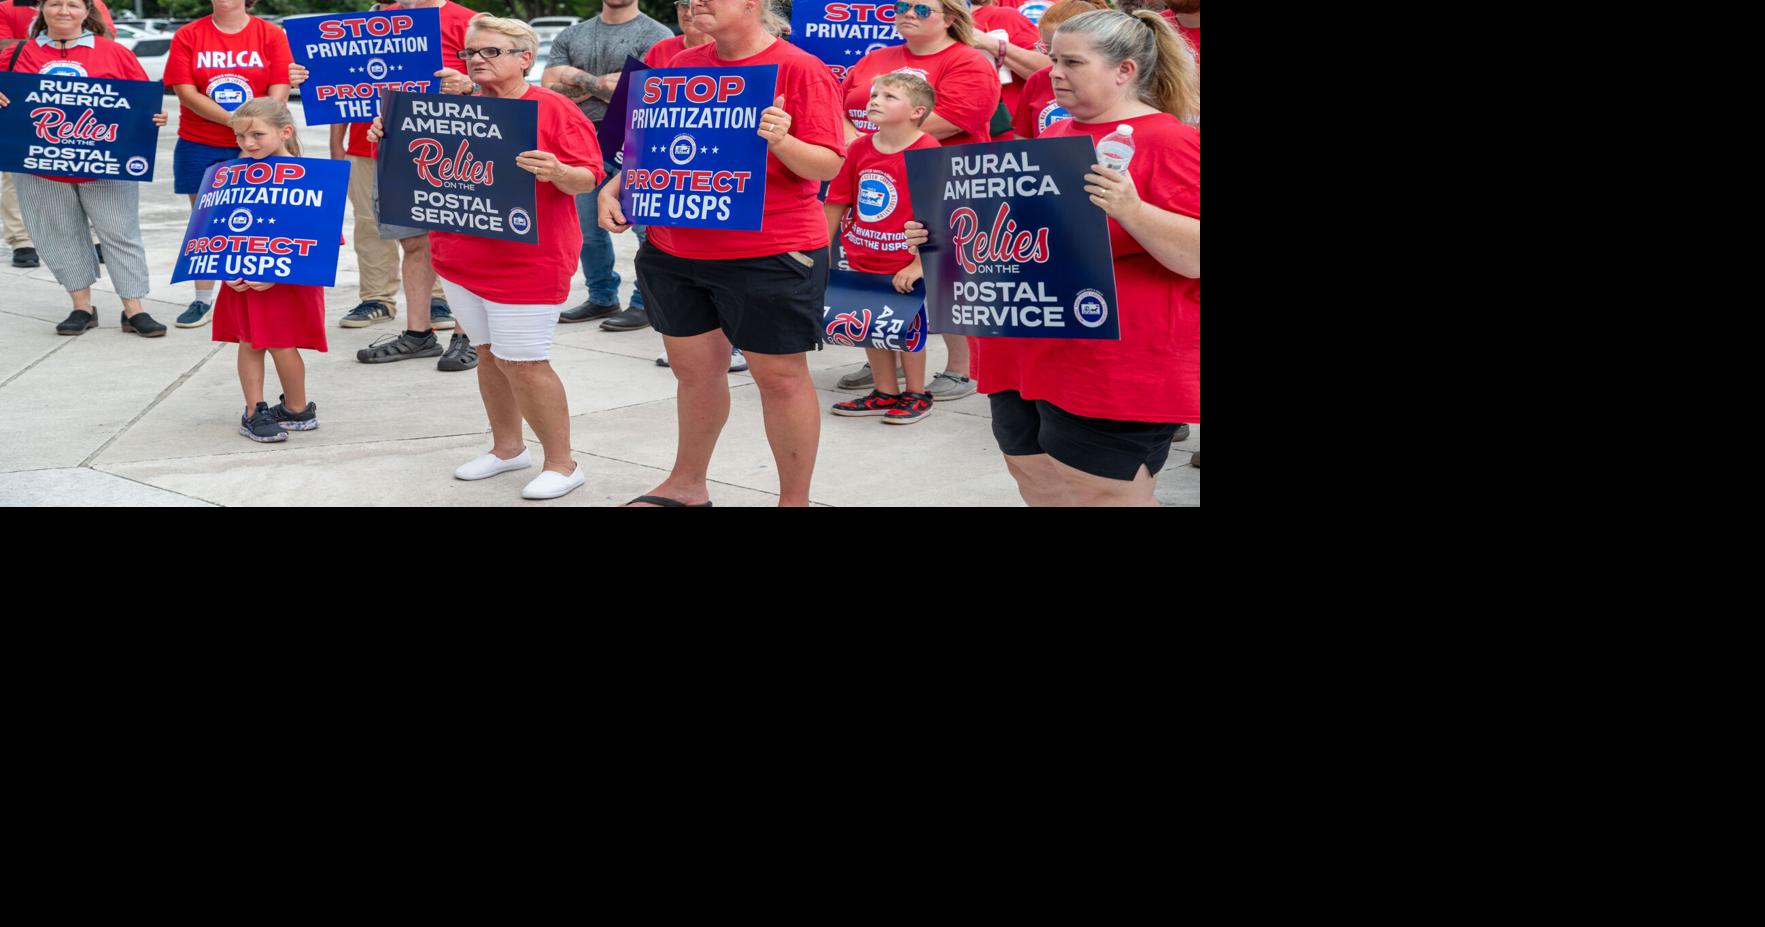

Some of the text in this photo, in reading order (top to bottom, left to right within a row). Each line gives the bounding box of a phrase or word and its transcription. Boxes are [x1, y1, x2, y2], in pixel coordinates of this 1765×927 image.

[824, 2, 897, 23] STO
[319, 15, 413, 40] STOP
[805, 23, 904, 40] PRIVATIZA
[305, 36, 428, 59] PRIVATIZATION
[197, 50, 264, 68] NRLCA
[40, 79, 119, 96] RURAL
[316, 80, 431, 101] PROTECT
[642, 75, 745, 104] STOP
[25, 92, 131, 109] AMERICA
[335, 100, 372, 118] THE
[412, 100, 490, 120] RURAL
[30, 107, 118, 144] Relies
[401, 117, 503, 139] AMERICA
[631, 107, 757, 129] PRIVATIZATION
[28, 145, 117, 162] POSTAL
[408, 137, 494, 187] Relies
[951, 151, 1040, 176] RURAL
[23, 157, 121, 174] SERVICE
[212, 162, 305, 188] STOP
[458, 182, 475, 191] THE
[625, 168, 751, 193] PROTECT
[943, 174, 1061, 200] AMERICA
[199, 187, 324, 210] PRIVATIZATION
[413, 190, 499, 214] POSTAL
[632, 192, 732, 221] THE USPS
[411, 206, 504, 232] SERVICE
[184, 235, 317, 256] PROTECT
[864, 239, 880, 250] THE
[881, 242, 908, 251] USPS
[950, 201, 1049, 274] Relies
[188, 254, 292, 277] THE USPS
[978, 265, 1020, 274] ON THE
[953, 282, 1058, 302] POSTAL
[952, 304, 1065, 327] SERVICE
